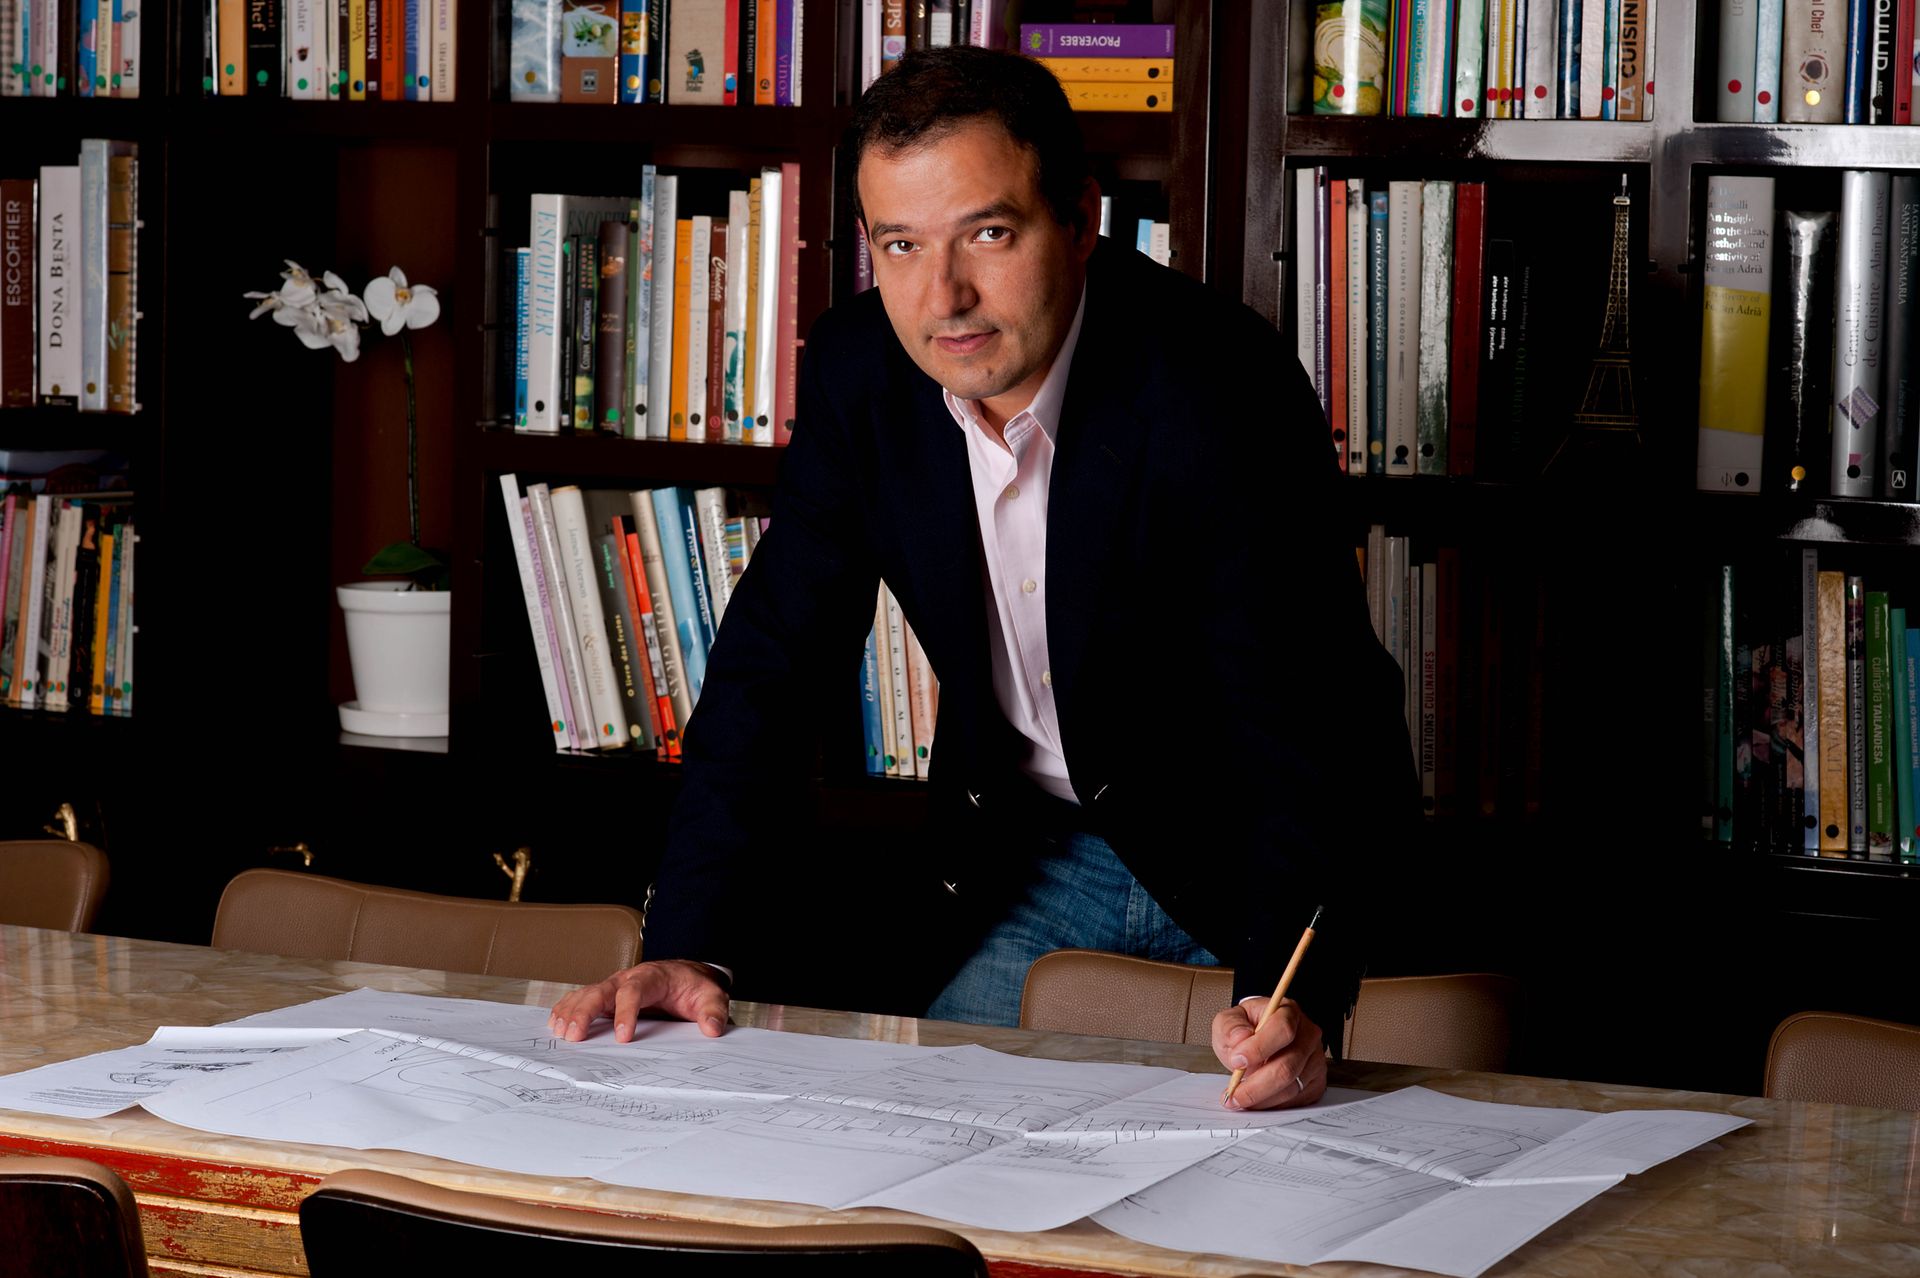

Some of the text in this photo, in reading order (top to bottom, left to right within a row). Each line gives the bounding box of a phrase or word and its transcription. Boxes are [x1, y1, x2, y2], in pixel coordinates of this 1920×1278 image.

[251, 0, 267, 32] hef
[297, 0, 308, 32] olate
[352, 5, 363, 41] Verres
[1060, 35, 1121, 47] PROVERBES
[1876, 0, 1892, 70] OULUD
[778, 53, 791, 97] vinos
[1618, 0, 1638, 115] LA CUISIN
[6, 199, 21, 307] ESCOFFIER
[1726, 226, 1741, 237] the
[1898, 203, 1911, 305] SANTI SANTAMARIA
[1910, 215, 1920, 244] COCINA
[50, 213, 64, 350] DONA BENTA
[535, 210, 557, 338] ESCOFFIER
[711, 255, 727, 303] Chocolate
[1374, 228, 1387, 361] party food for vegetarians
[1738, 264, 1763, 274] Adrià
[1863, 189, 1885, 367] de Cuisine Alain Ducasse
[1302, 282, 1313, 350] entertaining
[1315, 282, 1327, 322] Cuisiner
[1737, 304, 1763, 316] Adrià
[1844, 282, 1861, 367] Grand livre
[1315, 324, 1326, 372] autrement
[523, 515, 538, 556] MEXICAN
[532, 558, 550, 608] COOKING
[567, 527, 590, 598] James Peterson
[616, 612, 625, 641] frutas
[661, 644, 681, 697] GRAS
[863, 651, 875, 692] Banquete
[1424, 651, 1434, 773] VARIATIONS CULINAIRES
[1851, 664, 1864, 811] RESTAURANTS DE PARIS
[1871, 656, 1885, 765] culinária TAILANDESA
